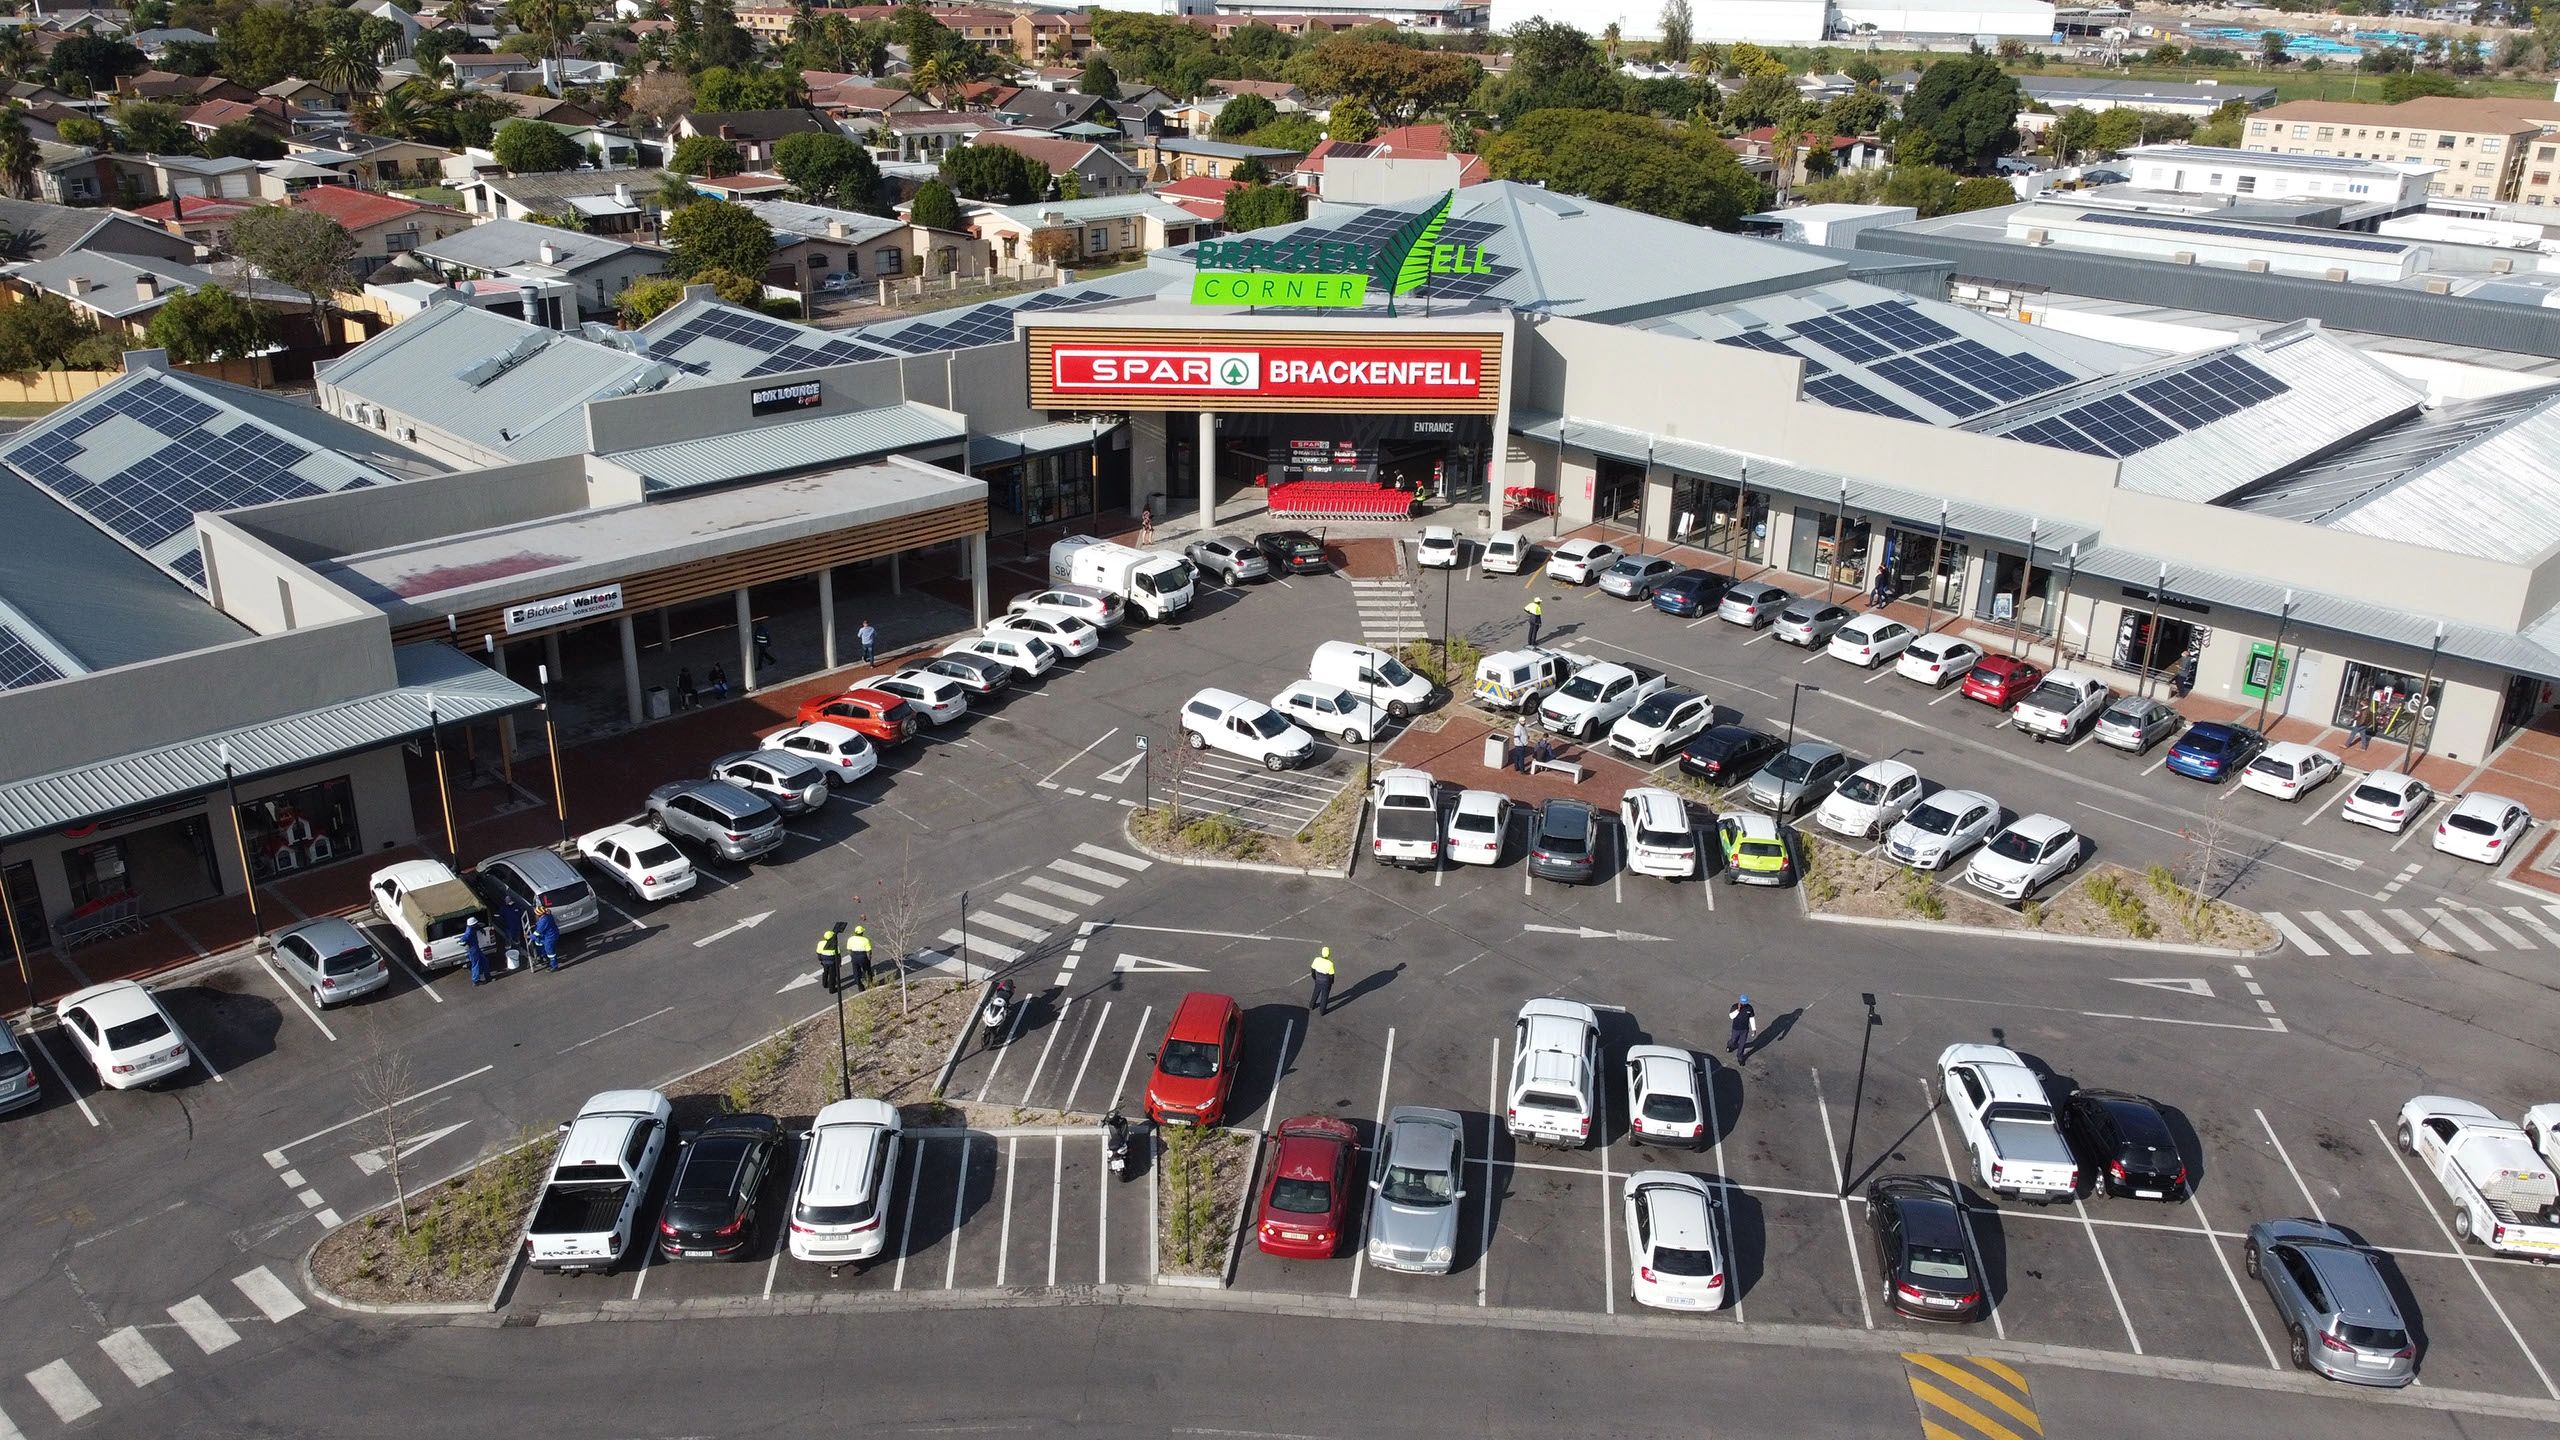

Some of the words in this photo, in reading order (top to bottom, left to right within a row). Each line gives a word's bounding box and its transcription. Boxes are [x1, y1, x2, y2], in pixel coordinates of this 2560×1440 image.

[1204, 279, 1354, 299] CORNER
[1092, 358, 1210, 384] SPAR
[1269, 361, 1477, 385] BRACKENFELL
[753, 390, 778, 405] BOK
[778, 383, 820, 400] LOUNGE
[1414, 422, 1454, 433] ENTRANCE
[527, 602, 568, 619] Bidvest
[573, 591, 618, 608] Waltons
[2002, 1178, 2069, 1187] RANGER
[542, 1249, 604, 1258] RANGER
